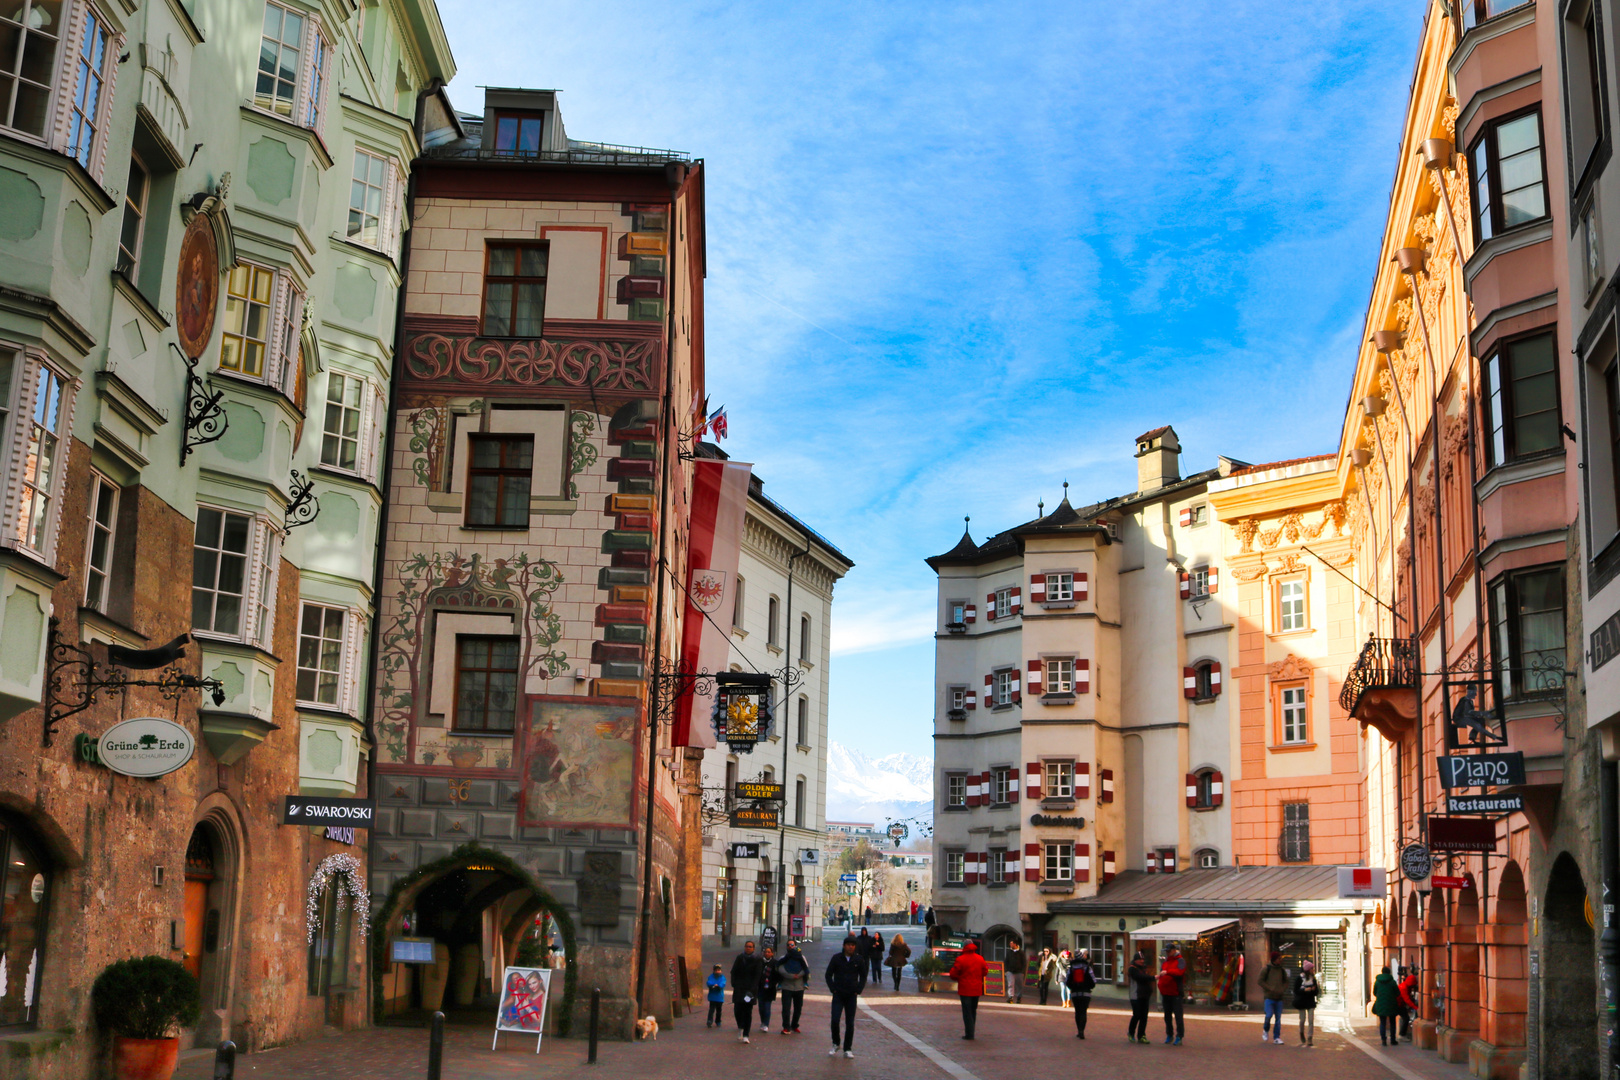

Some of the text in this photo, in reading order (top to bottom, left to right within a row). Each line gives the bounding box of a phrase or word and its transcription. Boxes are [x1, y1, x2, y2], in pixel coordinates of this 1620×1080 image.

[106, 740, 185, 751] Grüne Erde
[1451, 757, 1508, 787] Piano
[1468, 777, 1509, 786] Cafe Bar
[739, 784, 780, 792] GOLDENER
[745, 790, 772, 798] ADLER
[1449, 797, 1521, 811] Restaurant
[305, 805, 372, 819] SWAROVSKI
[737, 811, 777, 819] RESTAURANT
[1433, 841, 1495, 850] STADTMUSEUM
[1403, 849, 1430, 863] Tabak
[507, 977, 540, 1028] SALE
